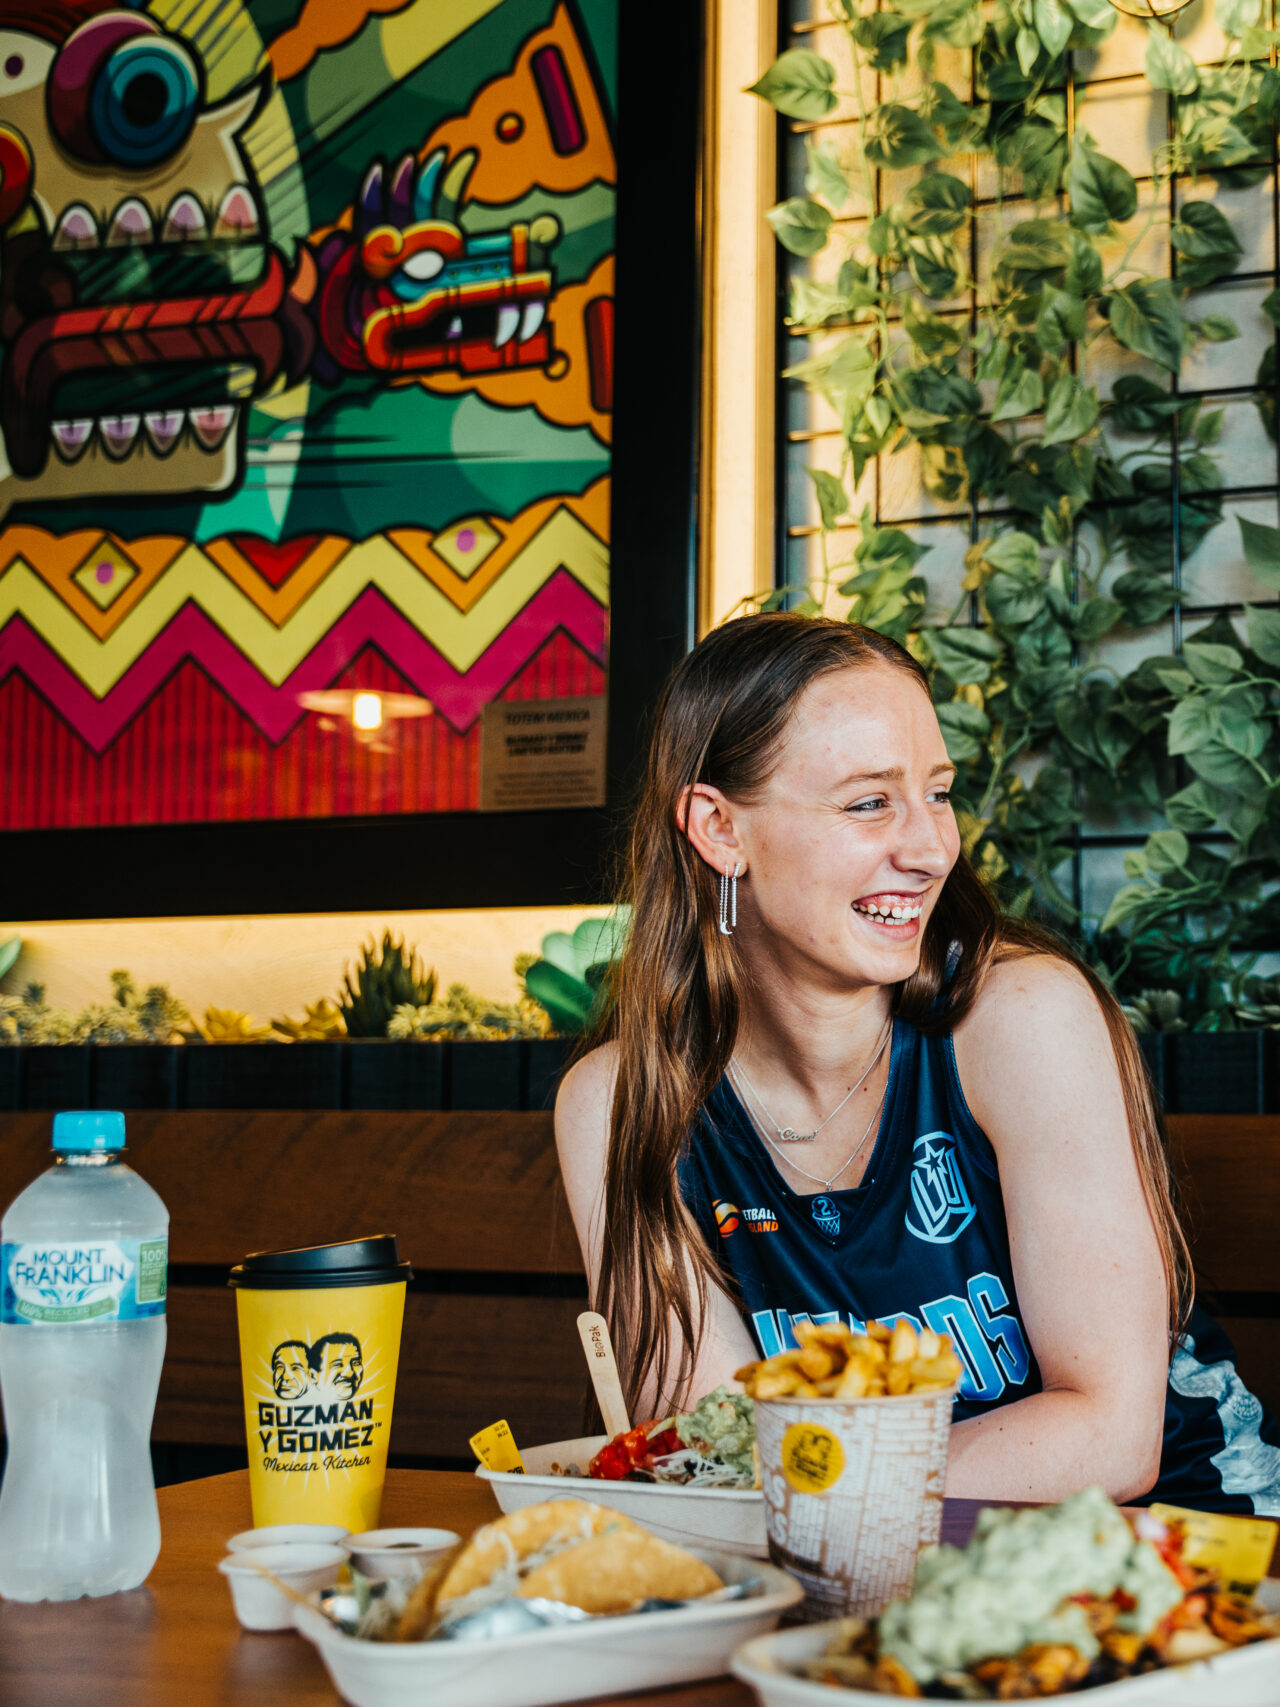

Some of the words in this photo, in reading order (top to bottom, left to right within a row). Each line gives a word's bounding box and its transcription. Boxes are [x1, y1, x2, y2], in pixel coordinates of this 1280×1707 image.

[817, 1199, 831, 1216] 2
[34, 1248, 106, 1266] MOUNT
[15, 1262, 126, 1286] FRANKLIN
[588, 1324, 606, 1358] BioPak
[258, 1399, 374, 1428] GUZMAN
[259, 1430, 273, 1453] Y
[277, 1424, 375, 1453] GOMEZ
[263, 1456, 319, 1472] Mexican
[323, 1454, 371, 1470] Kitchen
